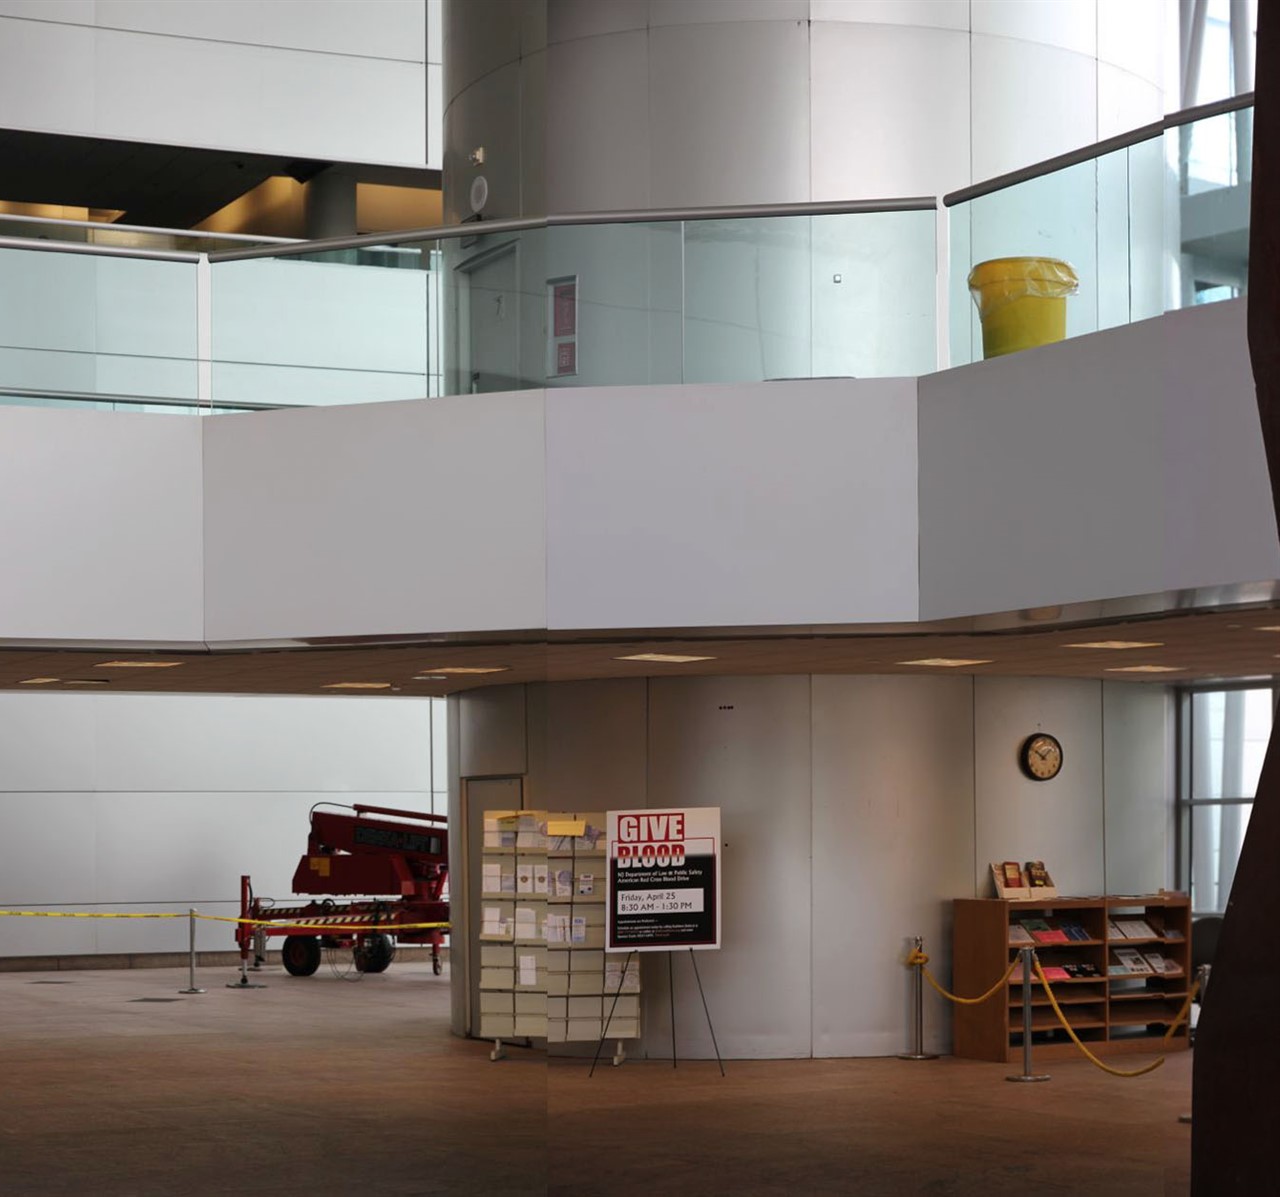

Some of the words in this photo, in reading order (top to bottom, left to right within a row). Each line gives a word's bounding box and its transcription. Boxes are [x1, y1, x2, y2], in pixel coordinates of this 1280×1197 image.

[620, 814, 683, 842] GIVE
[618, 844, 685, 868] BLOOD
[621, 893, 644, 902] Friday,
[646, 893, 664, 901] April
[666, 892, 676, 900] 25
[621, 903, 639, 912] 8:30
[640, 903, 655, 911] AM
[662, 902, 679, 910] 1:30
